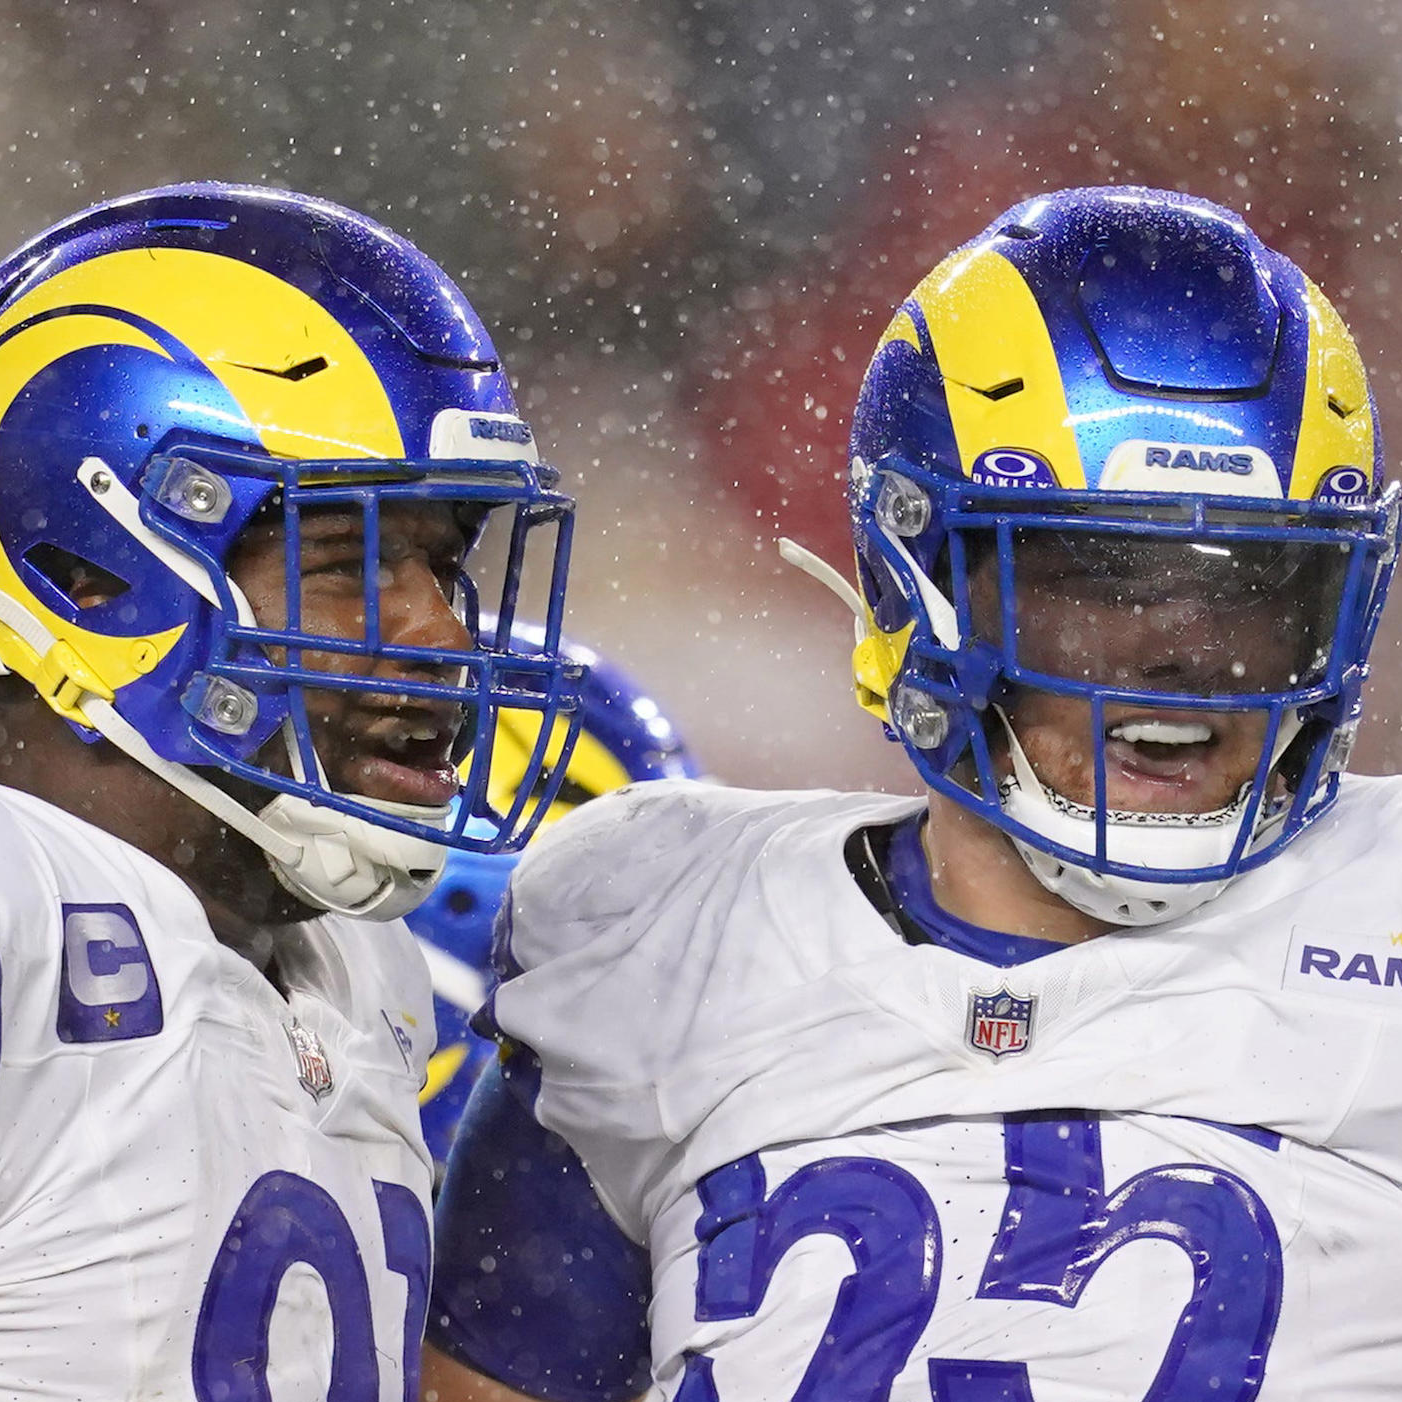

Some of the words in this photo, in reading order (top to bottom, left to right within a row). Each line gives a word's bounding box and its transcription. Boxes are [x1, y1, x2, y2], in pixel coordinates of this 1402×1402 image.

[1145, 447, 1254, 476] RAMS
[65, 911, 148, 1006] C
[975, 1020, 1023, 1050] NFL
